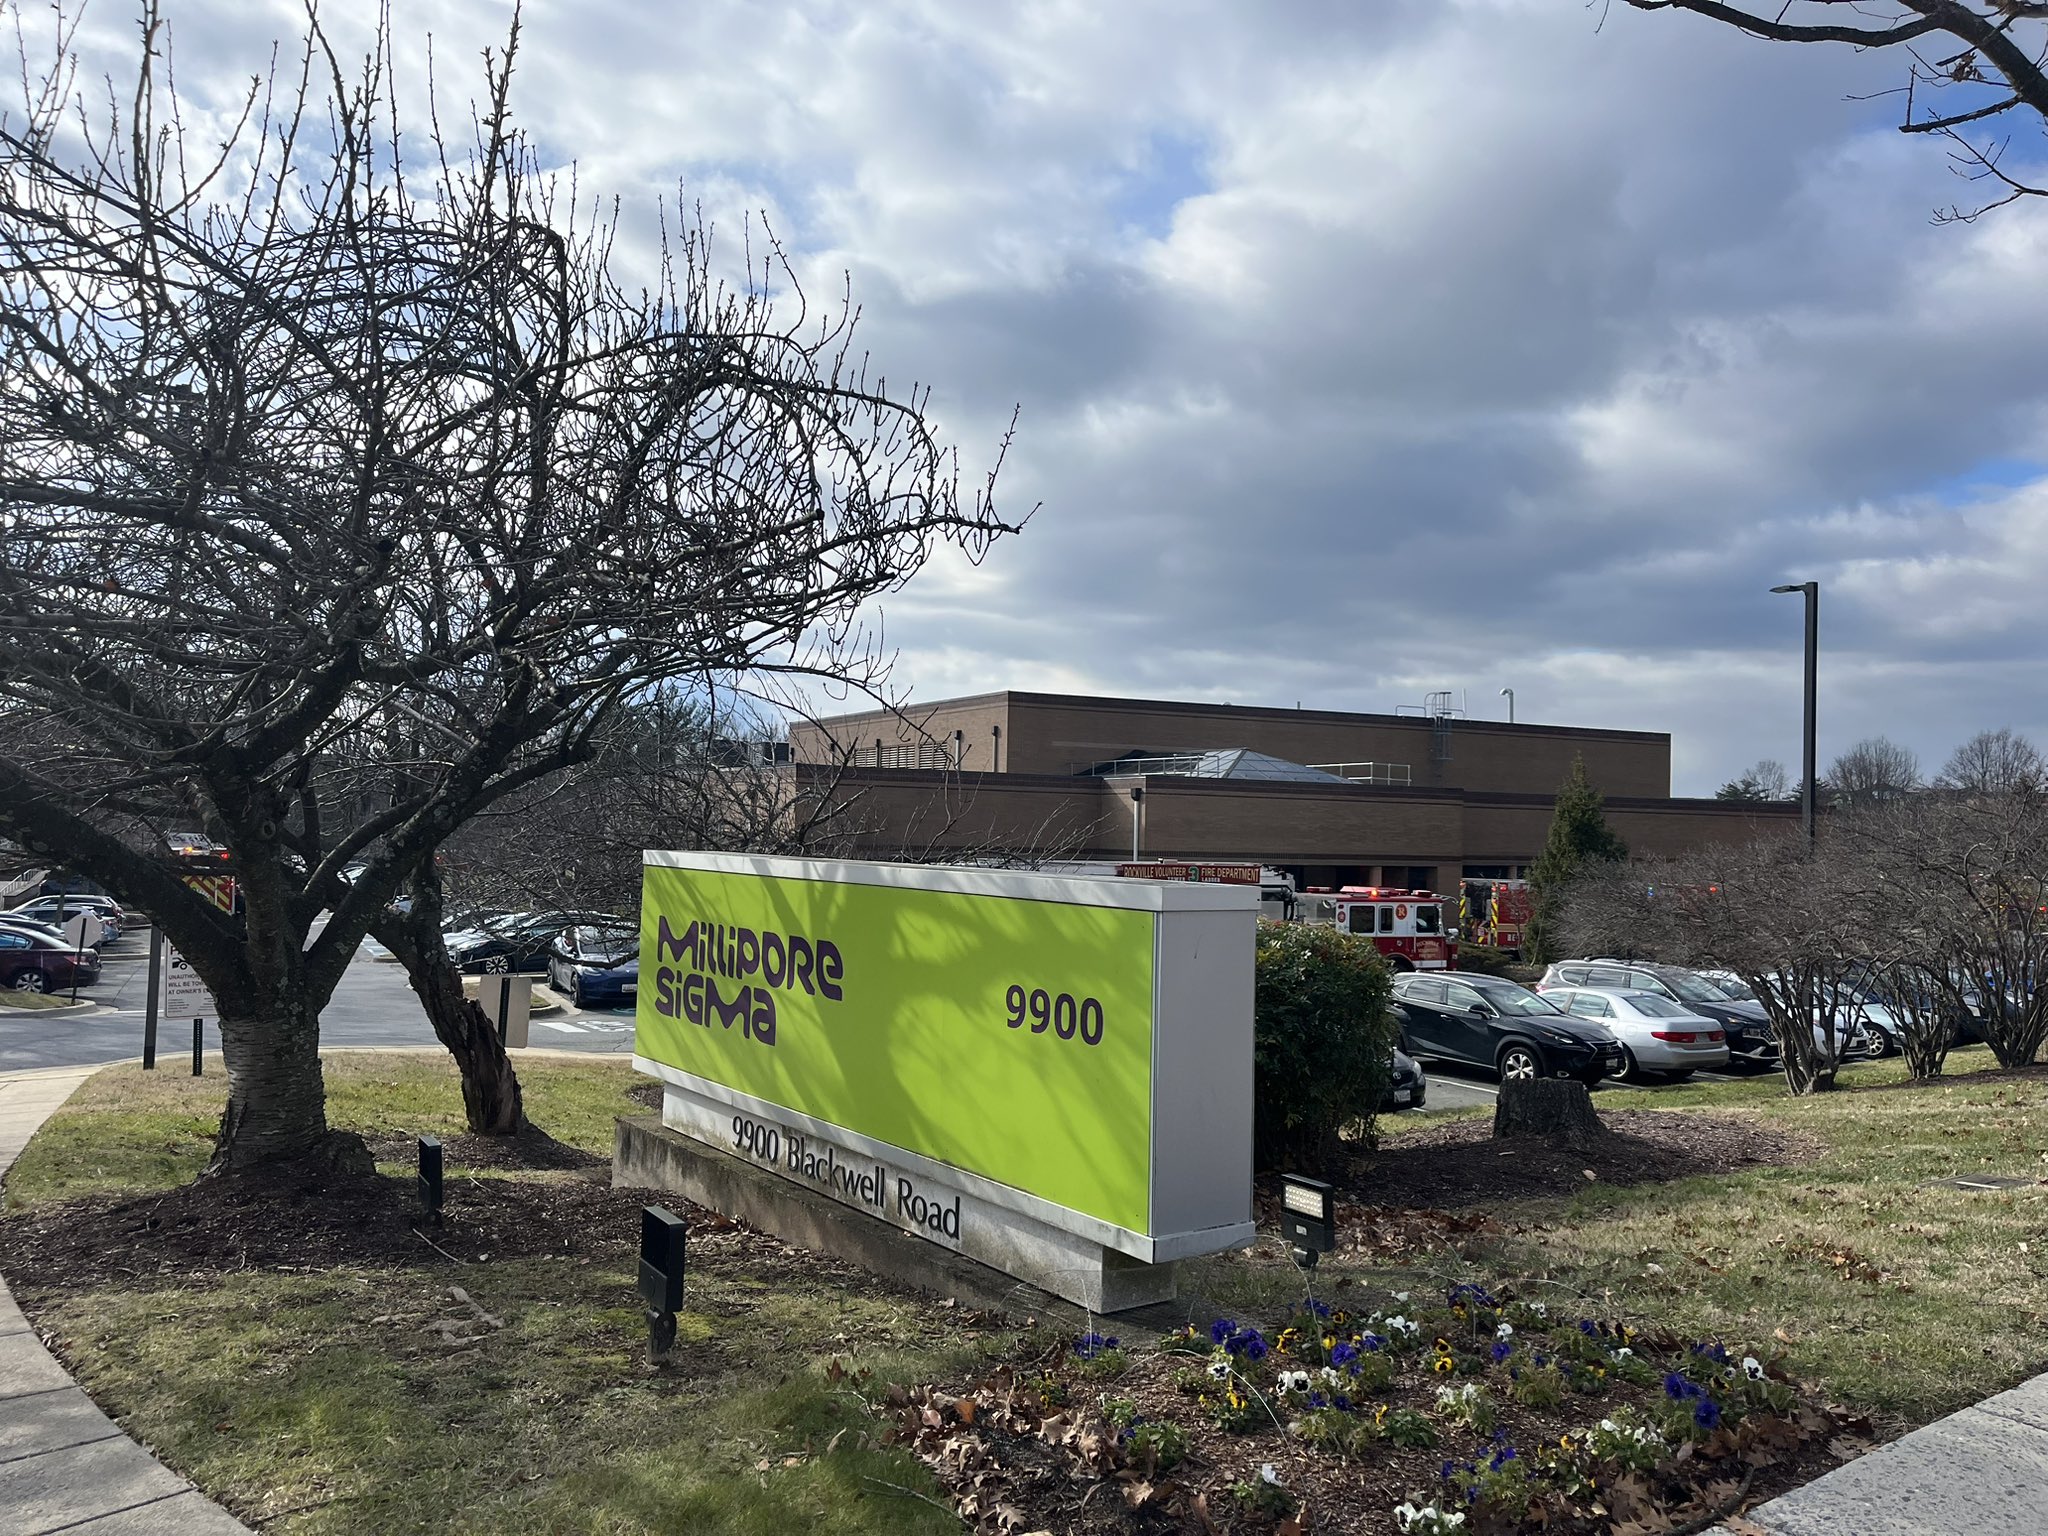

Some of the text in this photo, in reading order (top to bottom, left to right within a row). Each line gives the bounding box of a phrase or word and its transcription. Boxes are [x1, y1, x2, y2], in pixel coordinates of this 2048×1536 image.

[1123, 866, 1259, 882] ROCKVILLE VOLUNTEER 3 FIRE DEPARTMENT
[1006, 984, 1104, 1046] 9900
[732, 1115, 961, 1241] 9900 Blackwell Road
